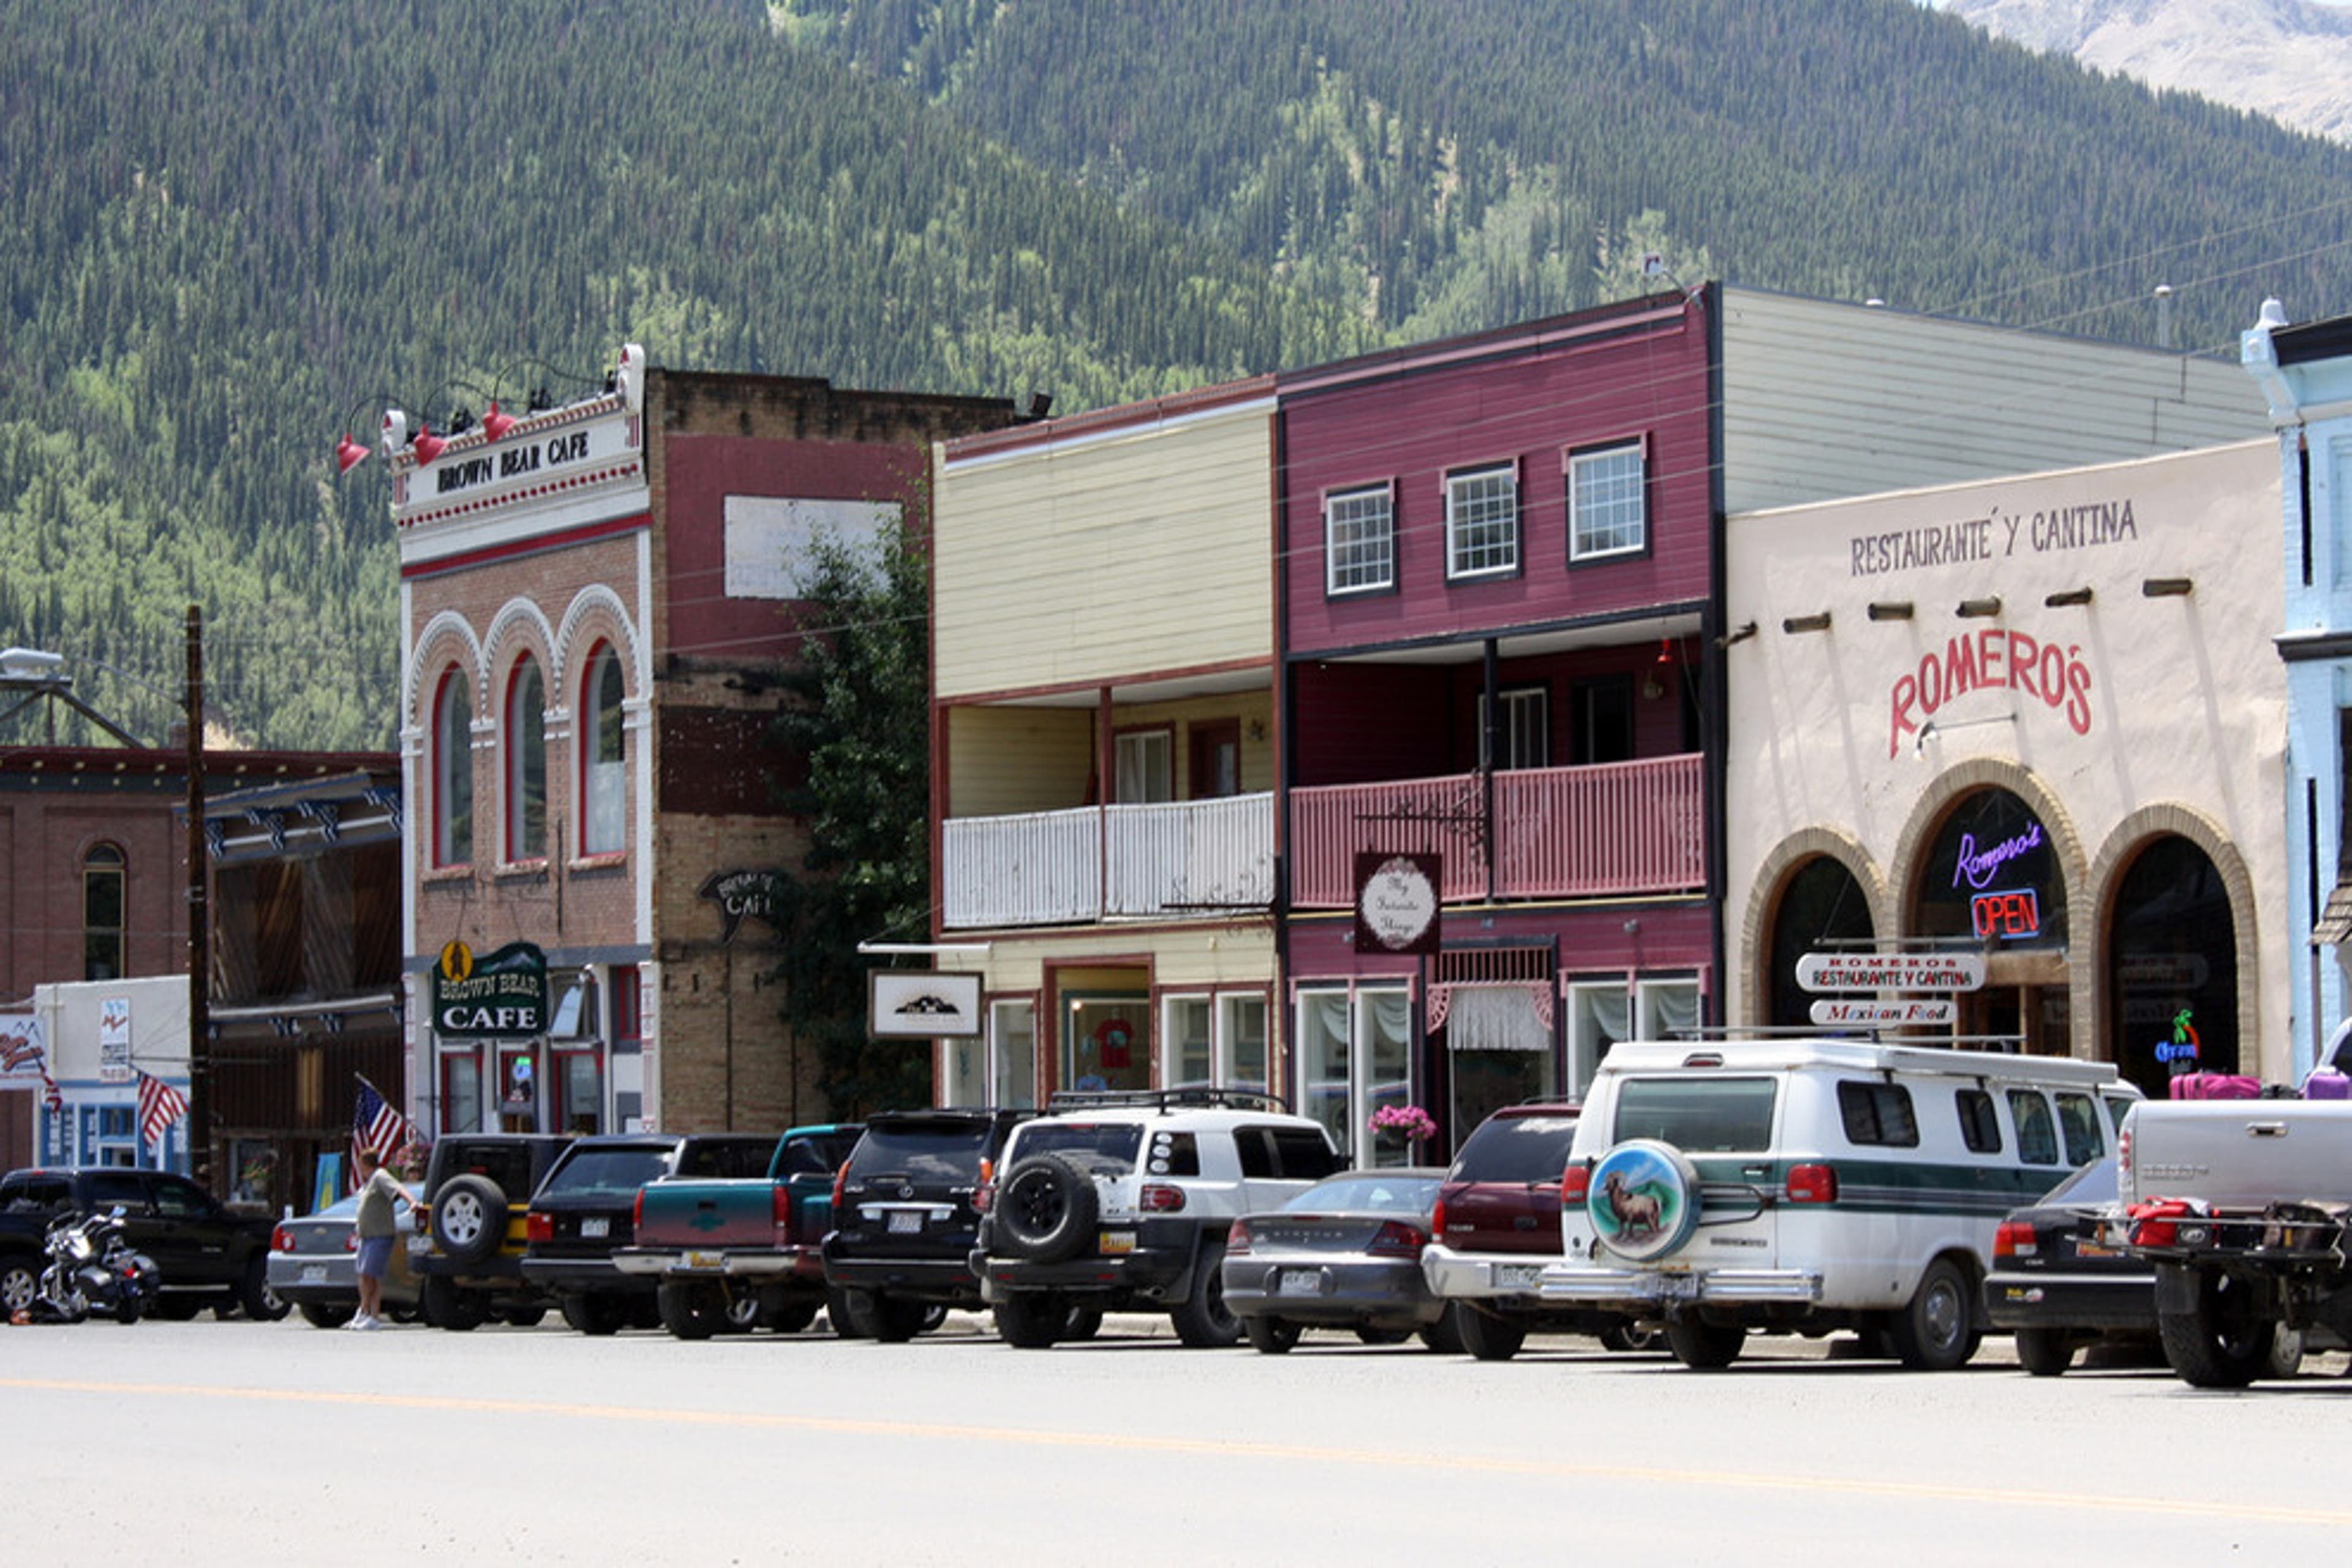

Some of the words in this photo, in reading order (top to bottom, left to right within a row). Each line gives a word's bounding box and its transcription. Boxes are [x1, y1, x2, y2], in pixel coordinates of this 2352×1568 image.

[439, 456, 493, 492] BROWN
[500, 447, 540, 476] BEAR
[548, 431, 588, 465] CAFE
[2004, 516, 2021, 556] Y
[2031, 499, 2138, 551] CANTINA
[1890, 629, 2092, 761] ROMERO'S
[1974, 894, 2038, 936] OPEN
[1828, 959, 1956, 968] ROMEROS
[440, 976, 495, 1000] BROWN
[499, 973, 540, 998] BEAR
[1812, 970, 1902, 987] RESTAURANTE
[1905, 971, 1916, 986] Y
[1917, 970, 1973, 987] CANTINA
[442, 1006, 538, 1030] CAFE
[1826, 1004, 1901, 1020] Mexican
[1905, 1005, 1948, 1020] Food
